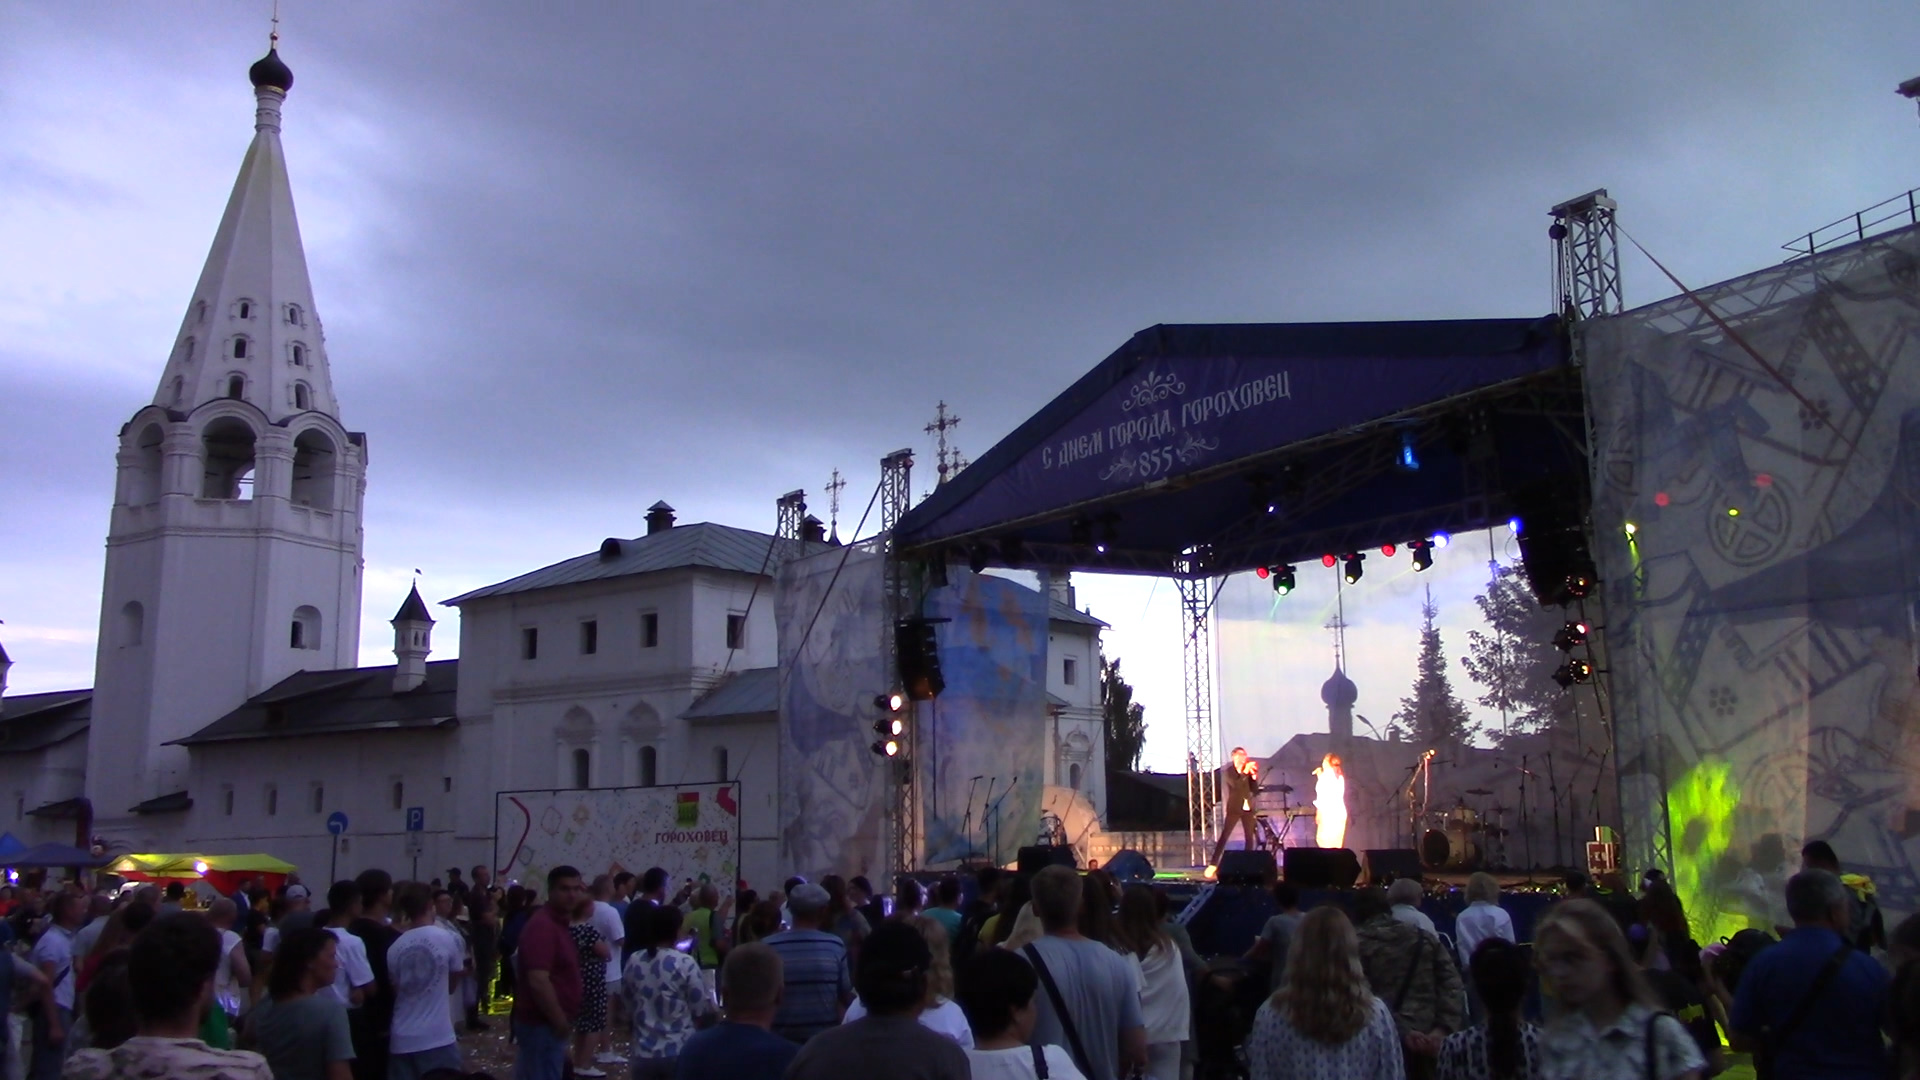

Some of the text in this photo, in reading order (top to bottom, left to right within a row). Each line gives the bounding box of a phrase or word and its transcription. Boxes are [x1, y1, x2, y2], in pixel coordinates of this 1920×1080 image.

[1042, 370, 1292, 470] С ДНЕМ ГОРОДА, ГОРОХОВЕЦ
[1139, 444, 1174, 477] 855
[411, 809, 421, 829] P
[654, 829, 728, 845] ГОРОХОВЕЦ
